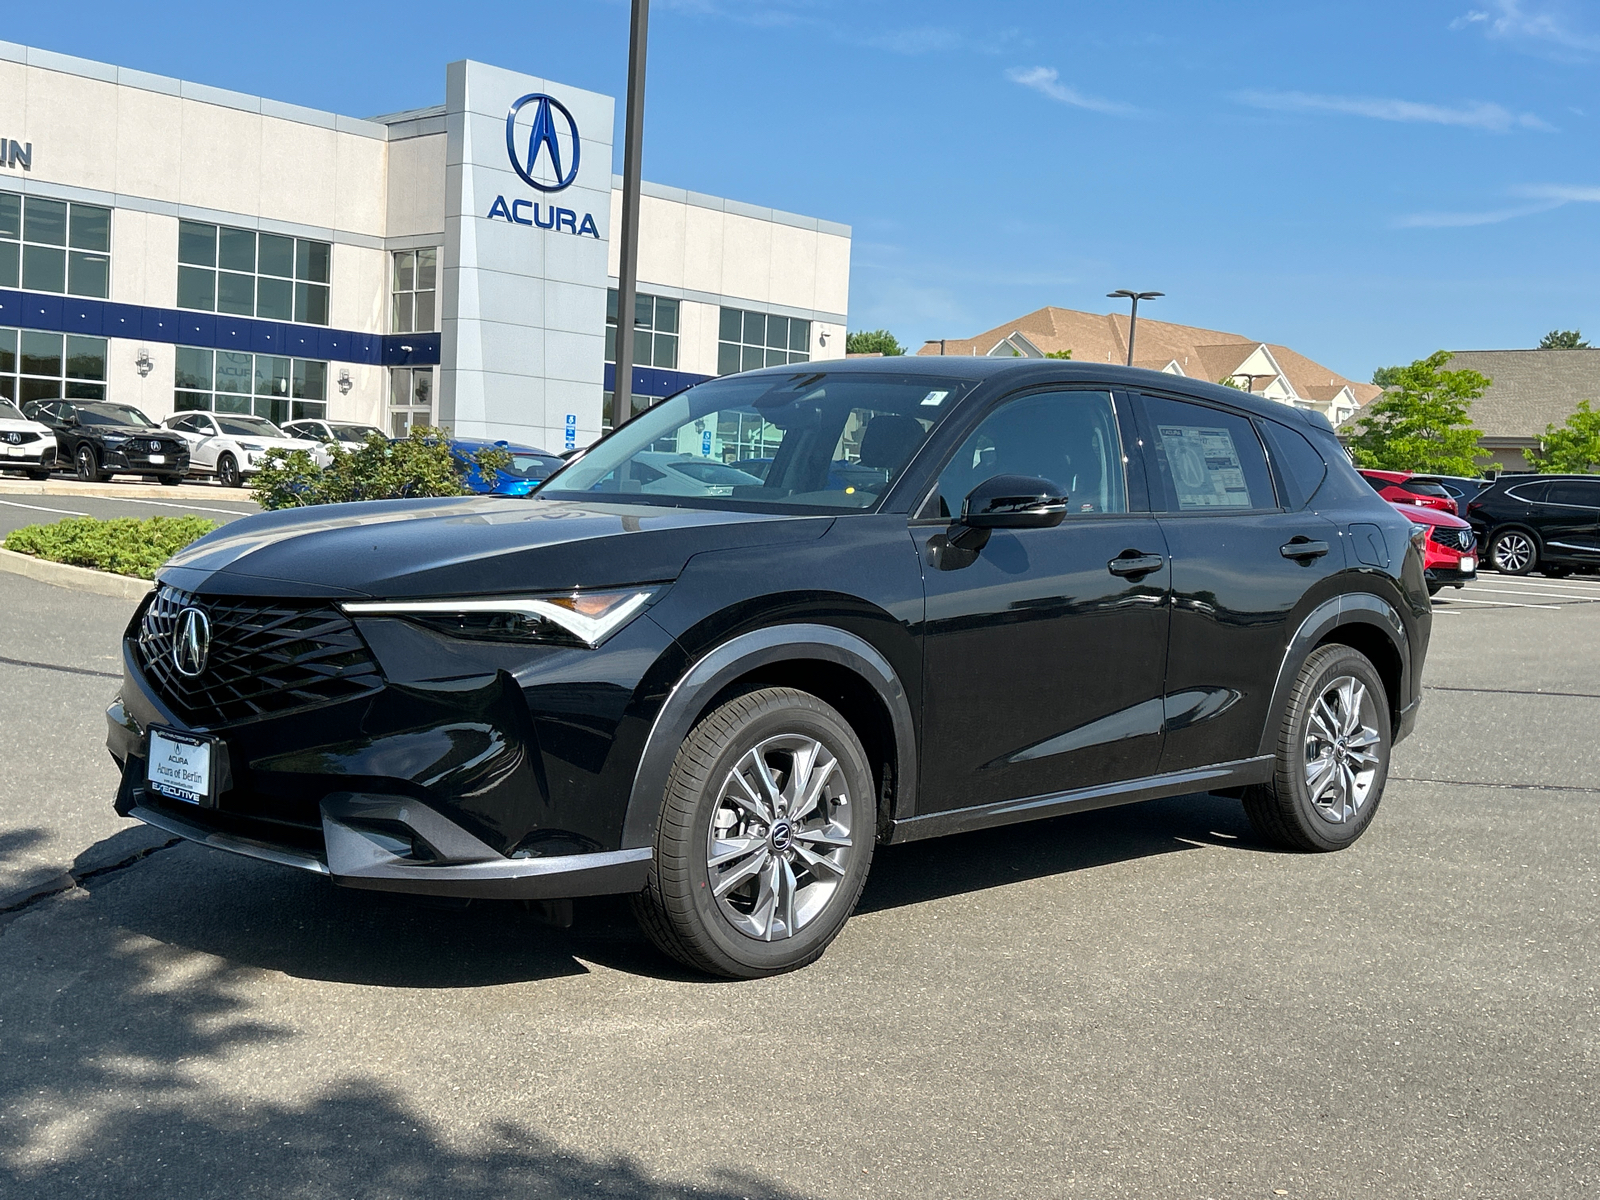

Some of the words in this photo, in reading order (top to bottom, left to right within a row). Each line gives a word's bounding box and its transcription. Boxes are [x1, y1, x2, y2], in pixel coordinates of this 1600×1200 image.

[487, 195, 600, 239] ACURA
[168, 755, 189, 766] ACURA
[157, 763, 173, 777] Acura
[174, 769, 181, 779] of
[182, 769, 203, 784] Berlin
[152, 782, 201, 802] EXECUTIVE
